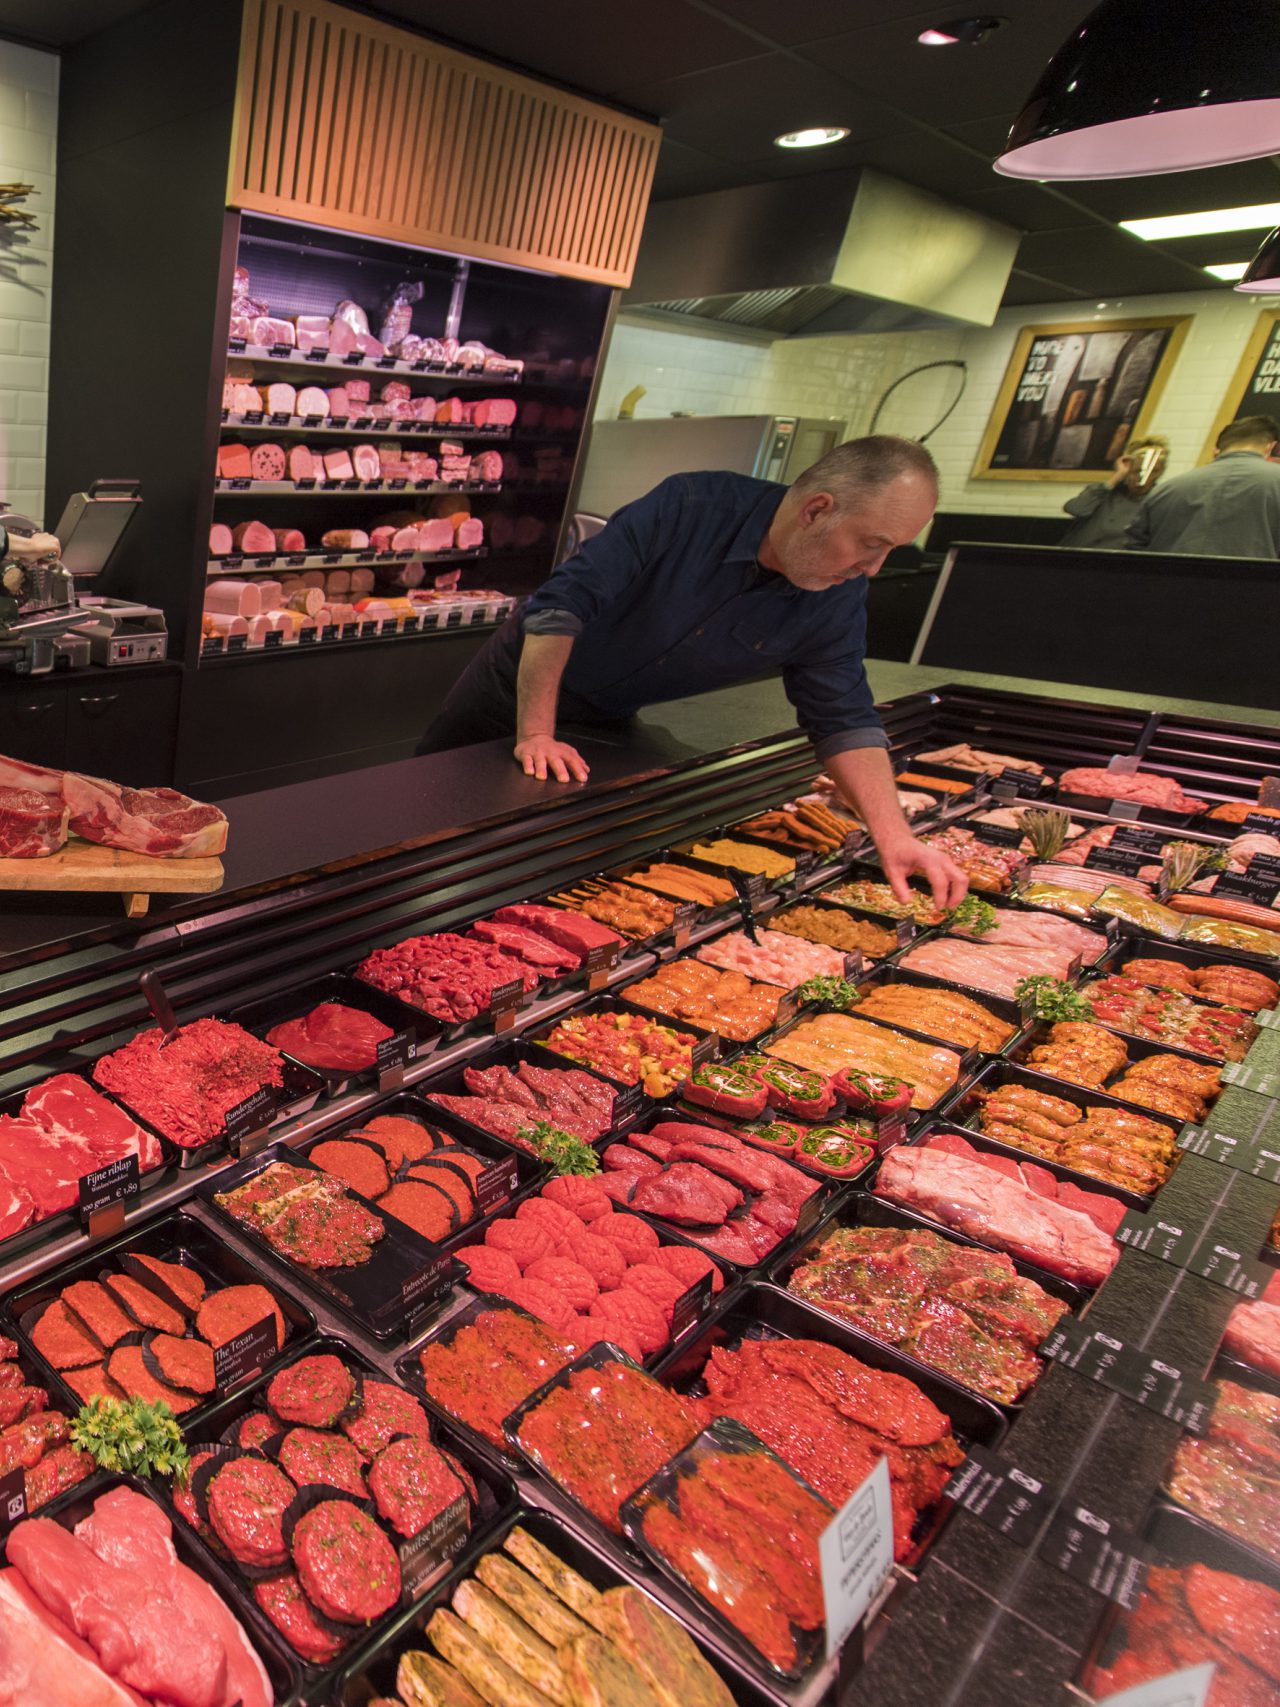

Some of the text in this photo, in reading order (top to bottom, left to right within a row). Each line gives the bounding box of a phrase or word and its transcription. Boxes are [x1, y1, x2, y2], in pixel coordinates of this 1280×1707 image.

[87, 1170, 108, 1188] Fijne
[108, 1159, 132, 1177] riblap
[93, 1194, 111, 1210] gram
[214, 1332, 255, 1363] The Texan
